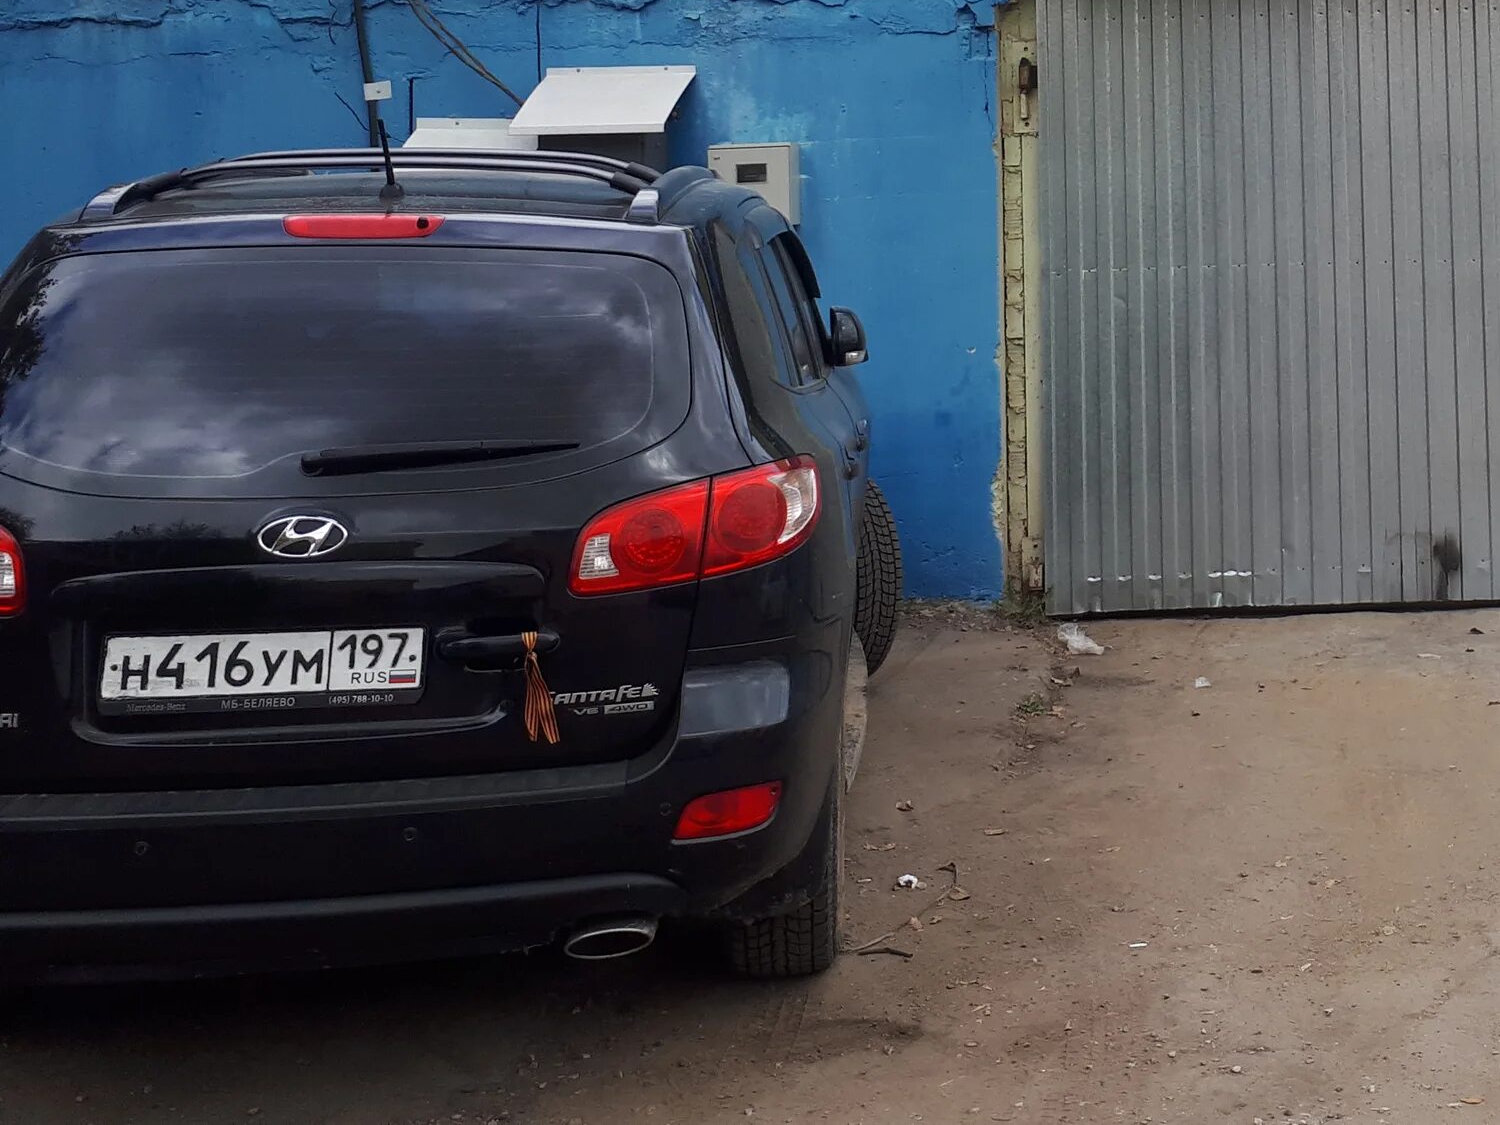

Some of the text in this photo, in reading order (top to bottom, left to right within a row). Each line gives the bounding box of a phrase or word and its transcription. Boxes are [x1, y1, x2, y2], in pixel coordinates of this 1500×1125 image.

[337, 632, 409, 670] 197
[350, 671, 387, 685] RUS
[220, 696, 296, 709] МБ-БЕЛЯЕВО
[328, 693, 394, 705] (495) 788-10-10
